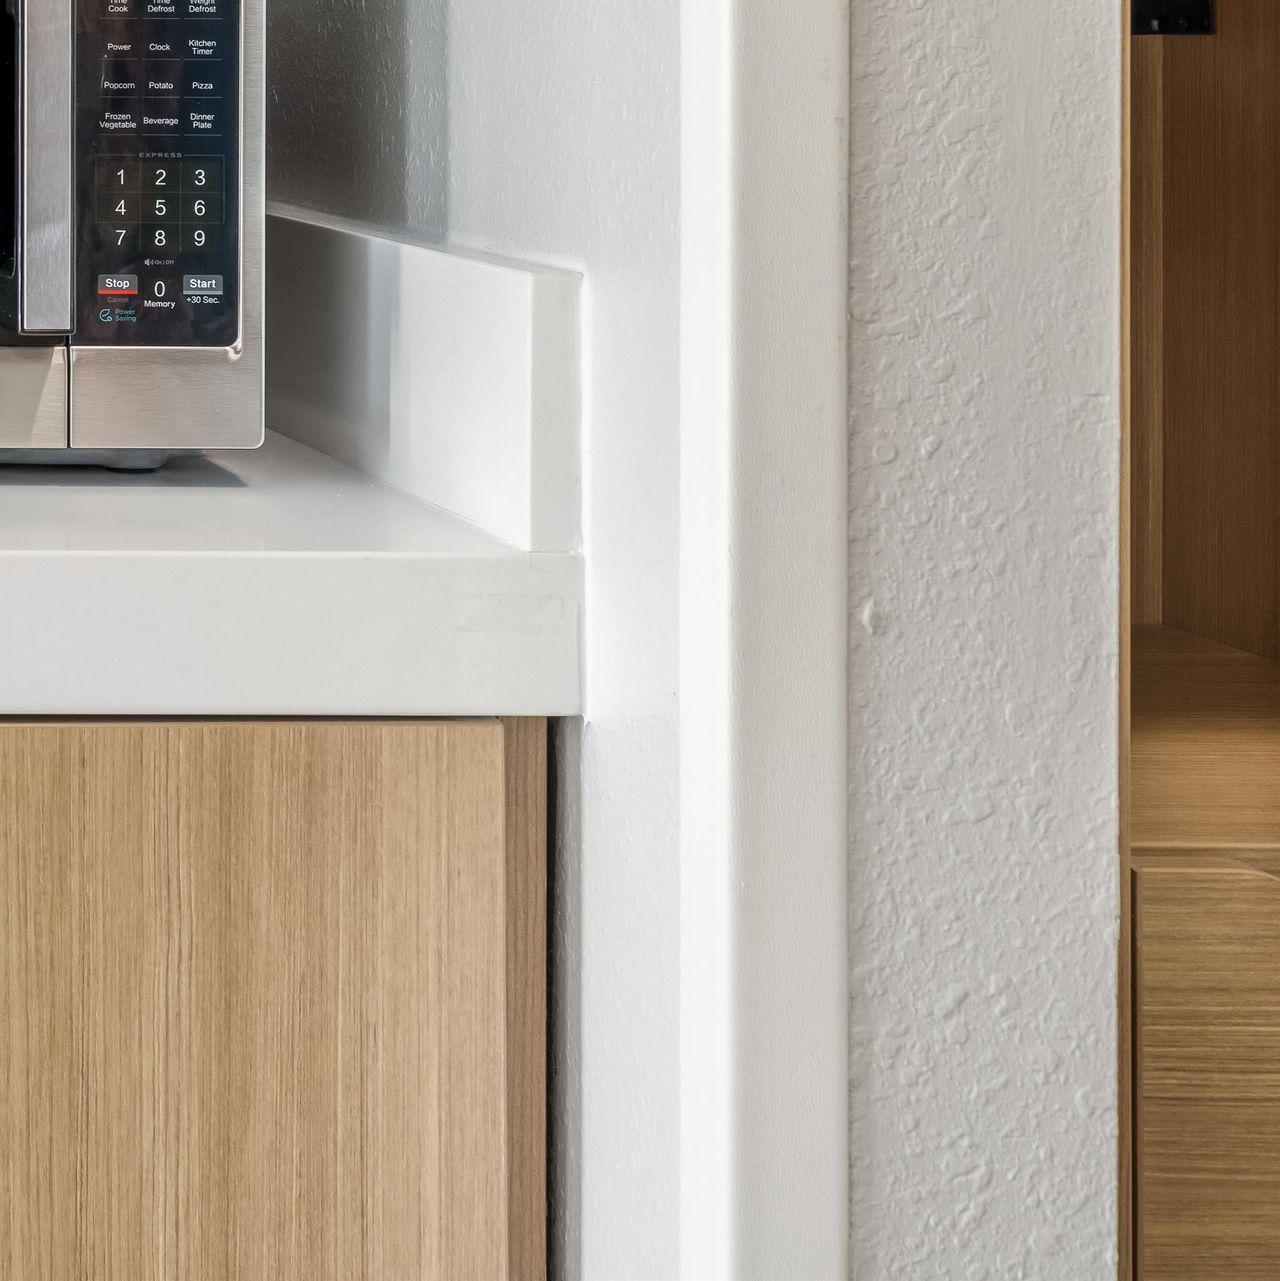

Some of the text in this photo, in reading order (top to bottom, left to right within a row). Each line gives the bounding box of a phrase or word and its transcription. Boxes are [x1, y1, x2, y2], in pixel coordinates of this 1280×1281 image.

[108, 5, 129, 13] Cook
[147, 5, 175, 13] Defrost
[188, 5, 217, 13] Defrost
[107, 43, 131, 51] Power
[149, 43, 171, 51] Clock
[104, 81, 136, 90] Popcorn
[148, 81, 174, 90] Potato
[192, 81, 213, 90] Pizza
[105, 112, 131, 120] Frozen
[99, 121, 137, 129] Vegetable
[143, 117, 179, 125] Beverage
[192, 121, 212, 129] Plate
[116, 169, 125, 185] 1
[155, 169, 166, 186] 2
[194, 169, 206, 186] 3
[114, 199, 127, 216] 4
[154, 199, 166, 216] 5
[194, 199, 206, 216] 6
[115, 229, 127, 246] 7
[154, 229, 166, 246] 8
[194, 230, 206, 246] 9
[105, 278, 130, 290] Stop
[189, 278, 216, 288] Start
[154, 281, 166, 297] 0
[144, 300, 176, 308] Memory
[186, 296, 220, 304] +30 Sec.
